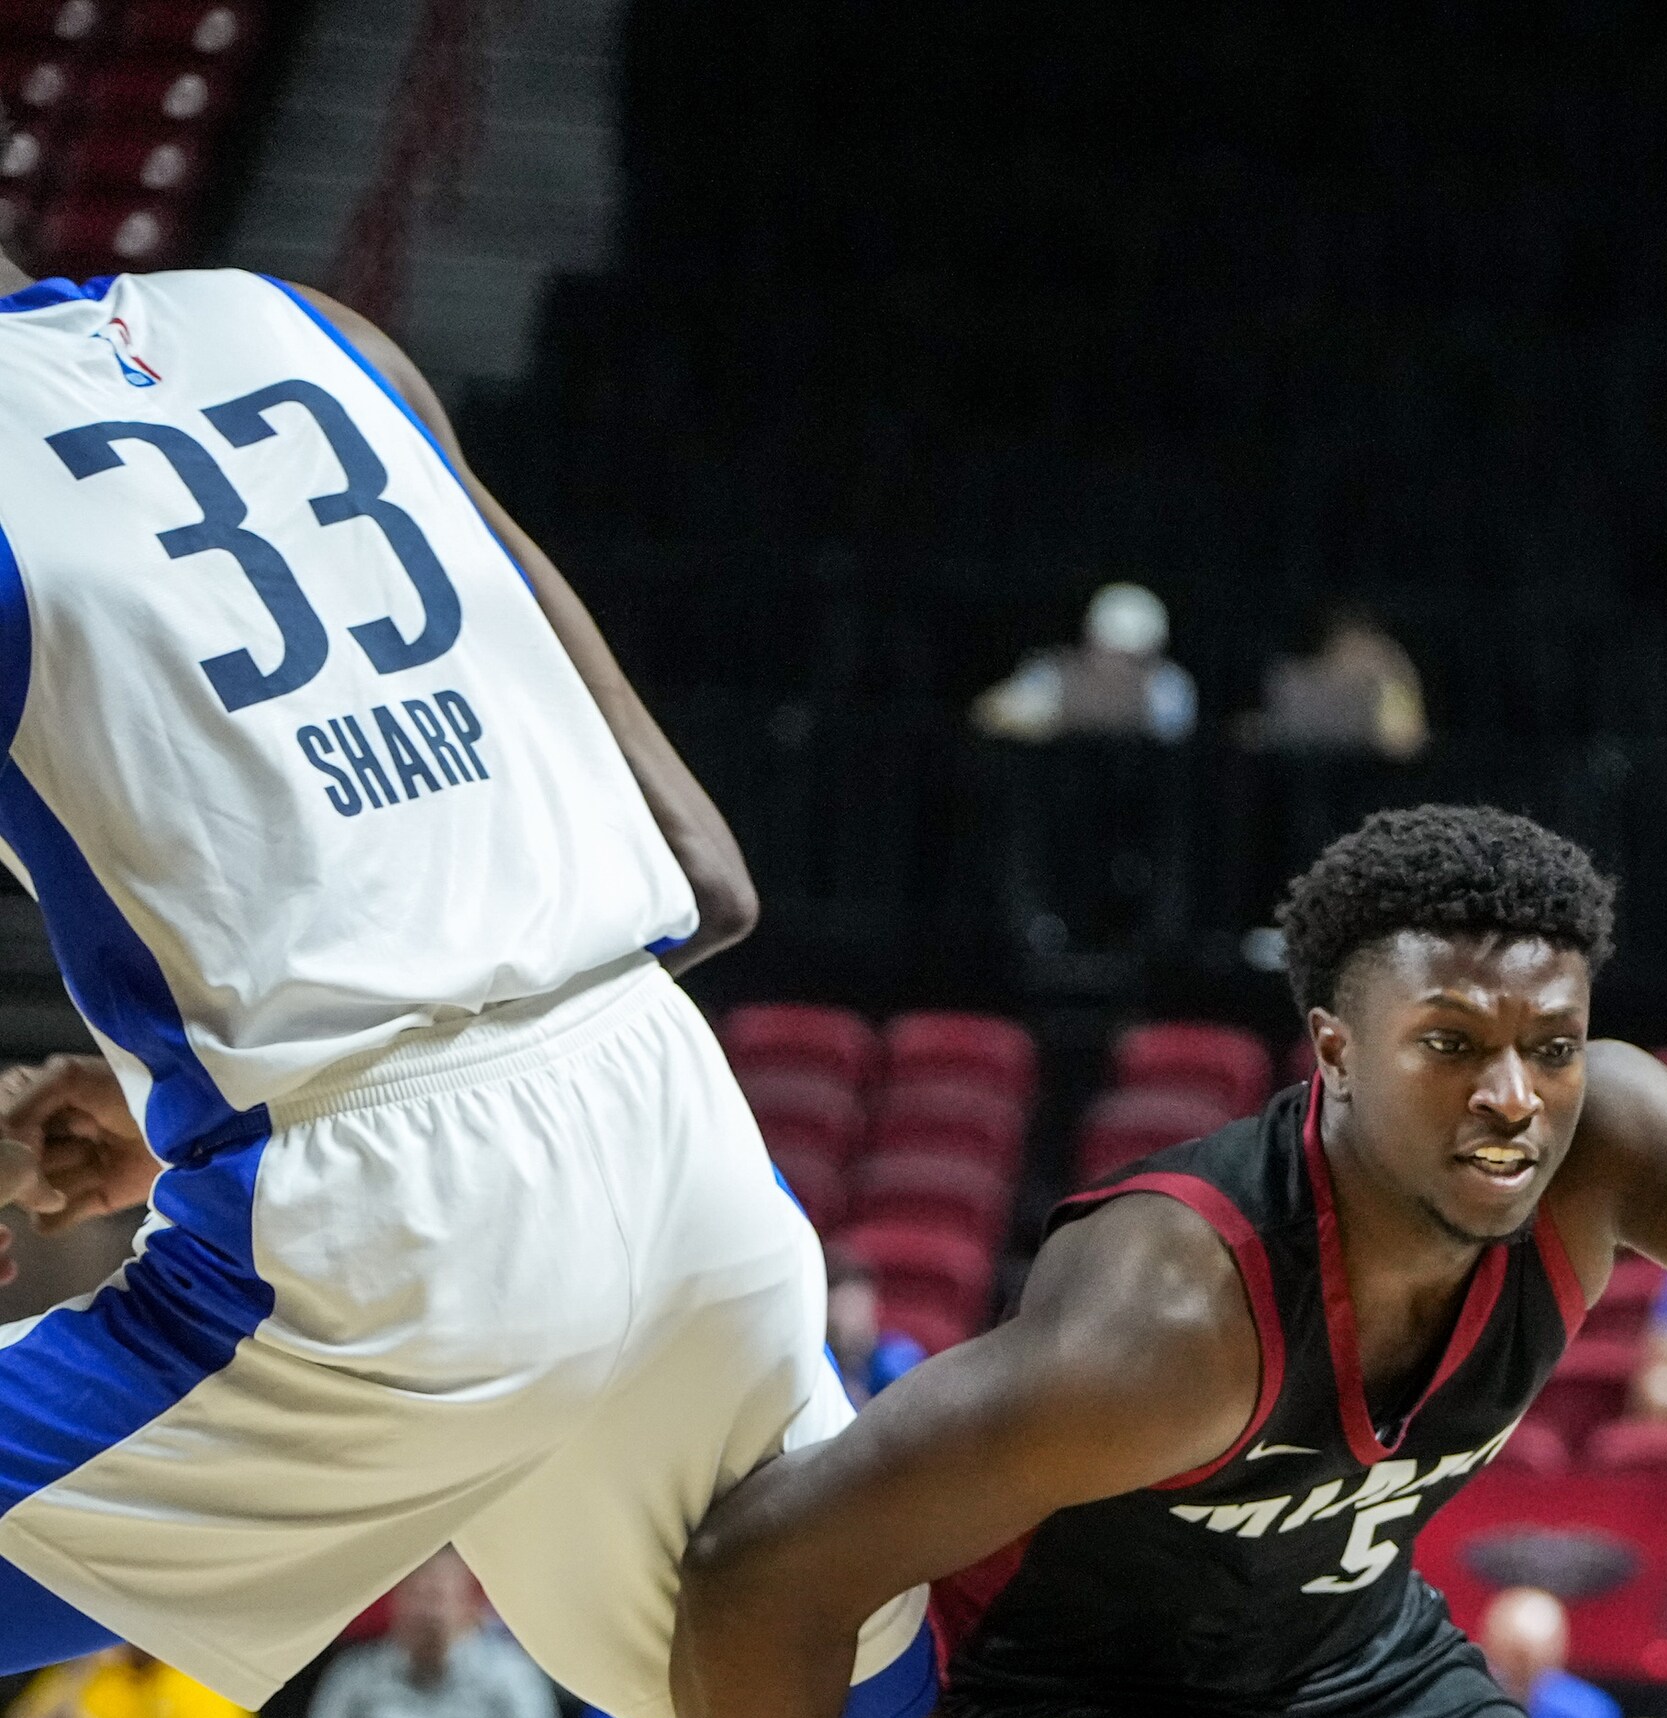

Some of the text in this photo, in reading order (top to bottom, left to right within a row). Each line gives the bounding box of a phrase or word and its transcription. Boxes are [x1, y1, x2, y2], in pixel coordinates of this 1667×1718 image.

[45, 379, 462, 713] 33
[296, 689, 490, 818] SHARP
[1300, 1494, 1422, 1594] 5
